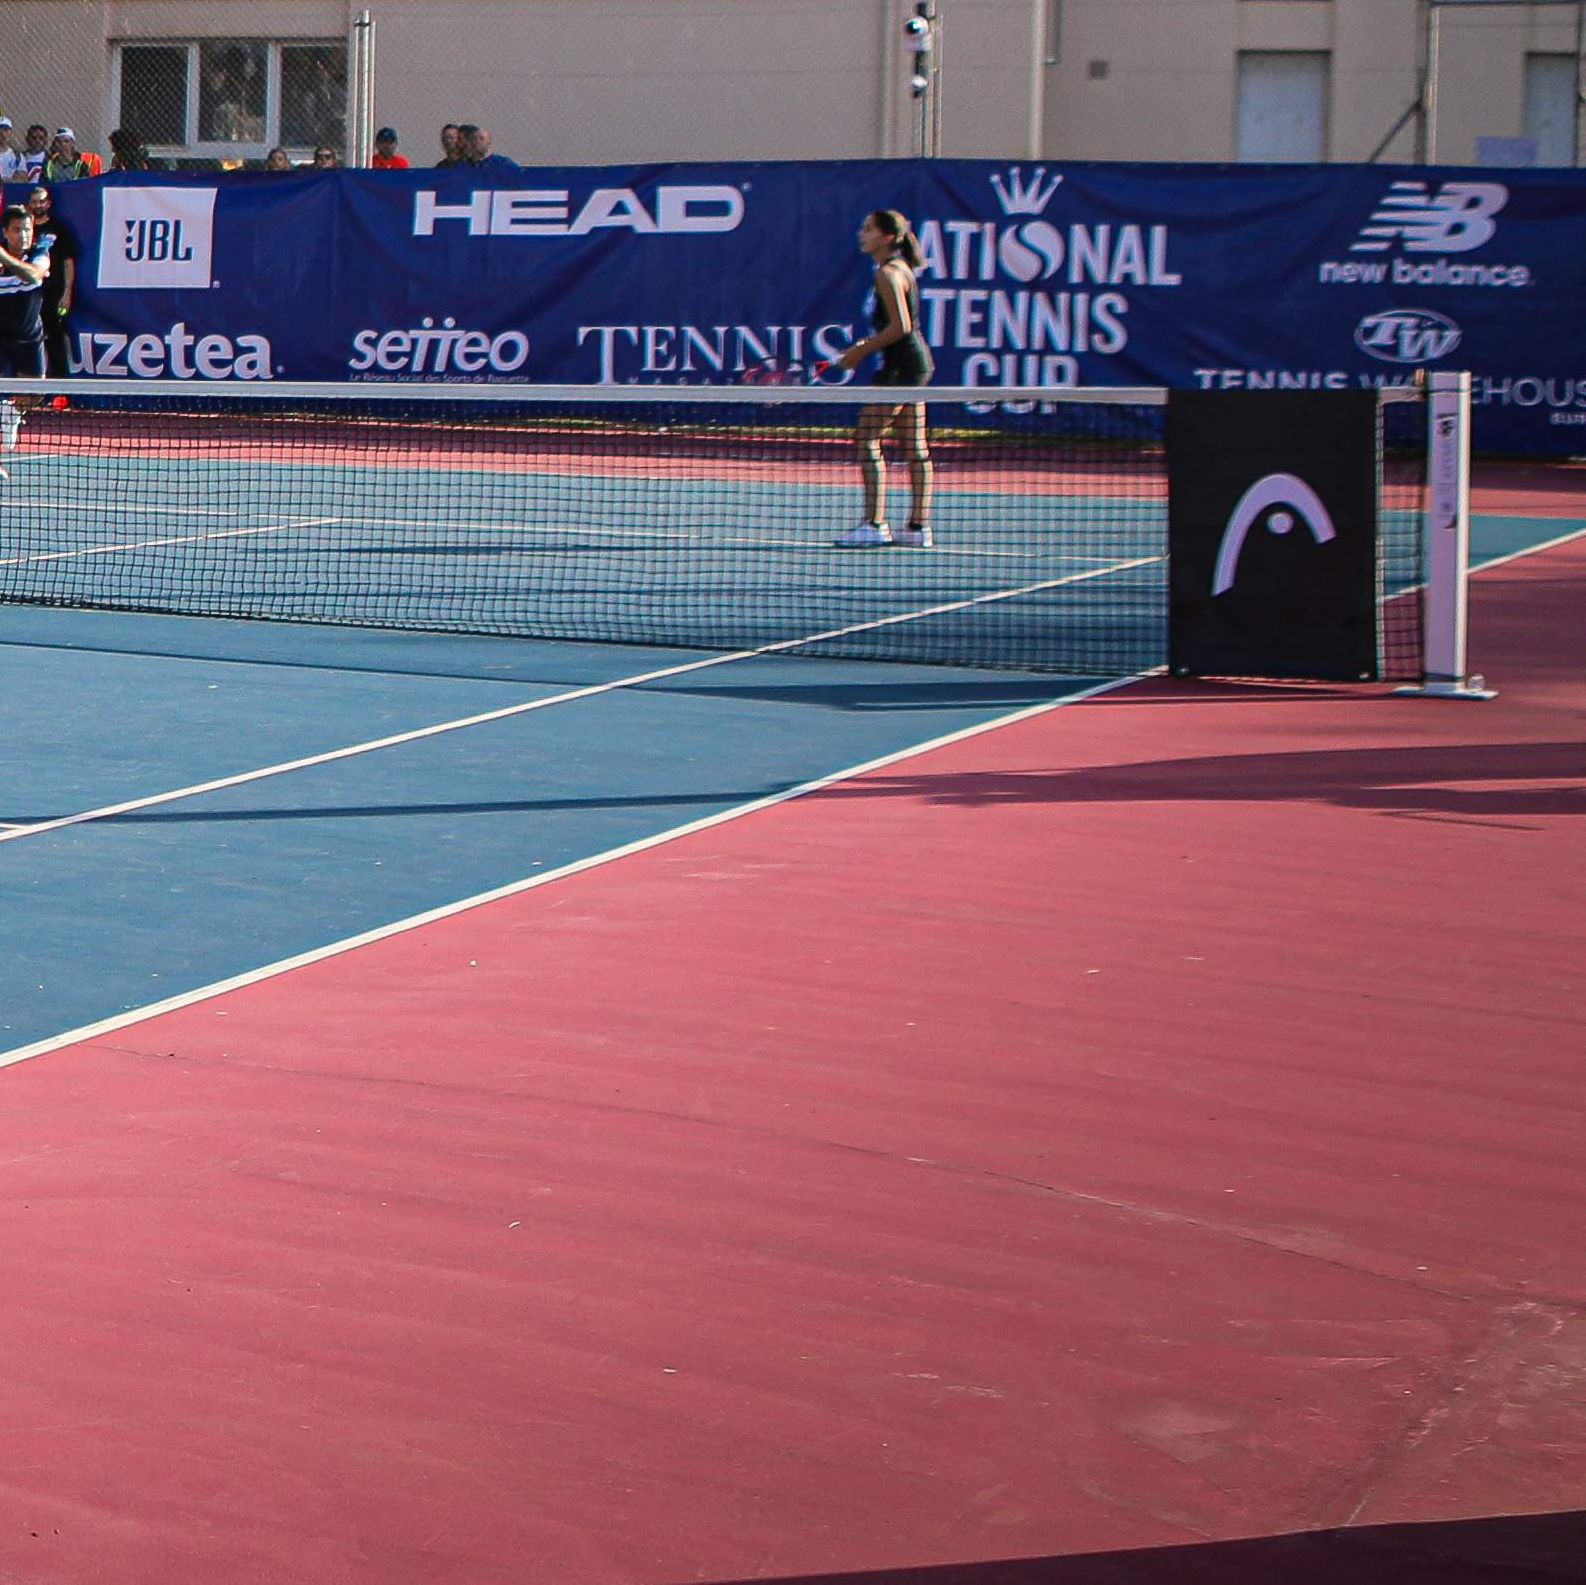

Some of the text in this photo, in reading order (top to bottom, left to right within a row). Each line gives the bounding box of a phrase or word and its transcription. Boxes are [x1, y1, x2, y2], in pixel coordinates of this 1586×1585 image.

[413, 185, 744, 235] HEAD
[125, 219, 193, 262] JBL
[907, 220, 1182, 285] ATIONAL
[1319, 258, 1531, 287] new balance
[920, 288, 1128, 354] TENNIS
[65, 322, 275, 379] uzetea
[578, 324, 856, 386] TENNIS
[1193, 368, 1349, 389] TENNIS
[962, 353, 1079, 414] CUP
